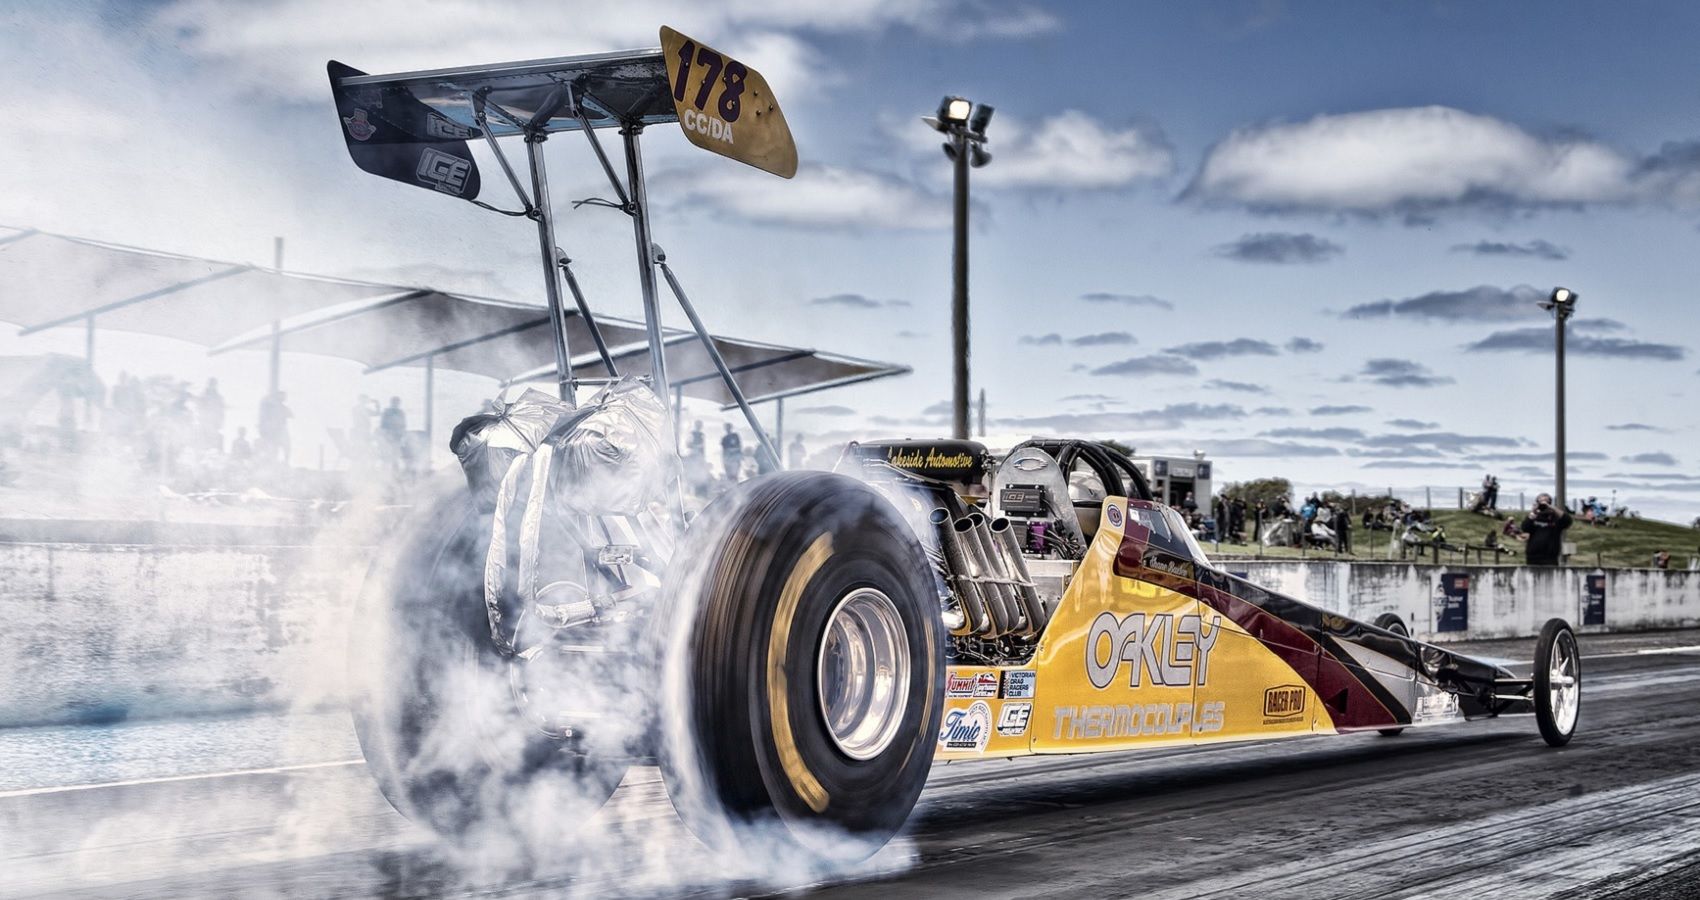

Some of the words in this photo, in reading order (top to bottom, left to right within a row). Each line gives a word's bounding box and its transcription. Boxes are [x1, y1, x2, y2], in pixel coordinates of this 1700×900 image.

[674, 40, 748, 123] 178
[684, 109, 734, 145] CC/DA
[417, 151, 470, 188] ICE
[888, 446, 924, 468] Lakeside
[924, 447, 973, 469] Automotive
[1085, 611, 1221, 689] OAKLEY
[997, 702, 1032, 732] ICE
[1053, 701, 1226, 739] THERMOCOUPLES
